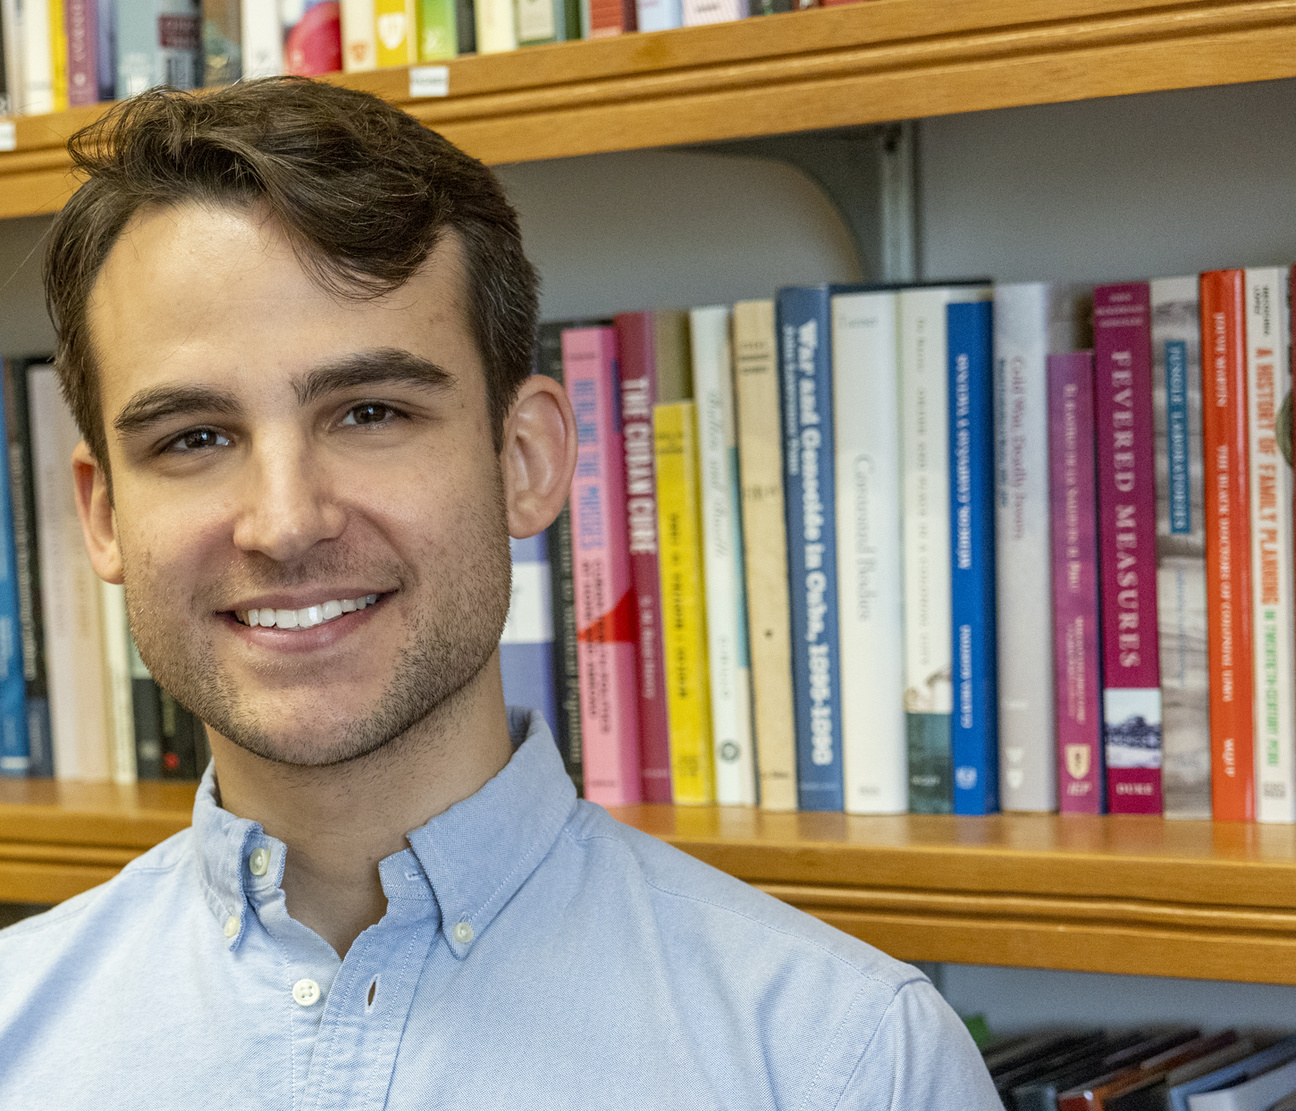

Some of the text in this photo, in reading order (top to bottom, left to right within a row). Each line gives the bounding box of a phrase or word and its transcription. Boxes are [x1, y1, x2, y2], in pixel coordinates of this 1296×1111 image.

[797, 319, 818, 376] War
[573, 379, 598, 444] HEALING
[799, 378, 821, 426] and
[1111, 351, 1137, 492] FEVERED
[577, 451, 601, 478] THE
[622, 377, 657, 554] THE CUBAN CURE
[1168, 345, 1189, 530] JUNGLE LABORATORIES
[1217, 445, 1229, 470] THE
[801, 428, 825, 541] Genocide
[1217, 473, 1230, 514] BLACK
[1256, 347, 1280, 605] A HISTORY OF FAMILY PLANNING
[579, 485, 604, 549] MASSES
[1218, 517, 1231, 580] DOCTORS
[805, 543, 826, 569] in
[1115, 504, 1141, 668] MEASURES
[804, 571, 828, 642] Cuba,
[1220, 581, 1232, 600] OF
[1220, 602, 1233, 667] COLONIAL
[1116, 782, 1154, 797] DUKE
